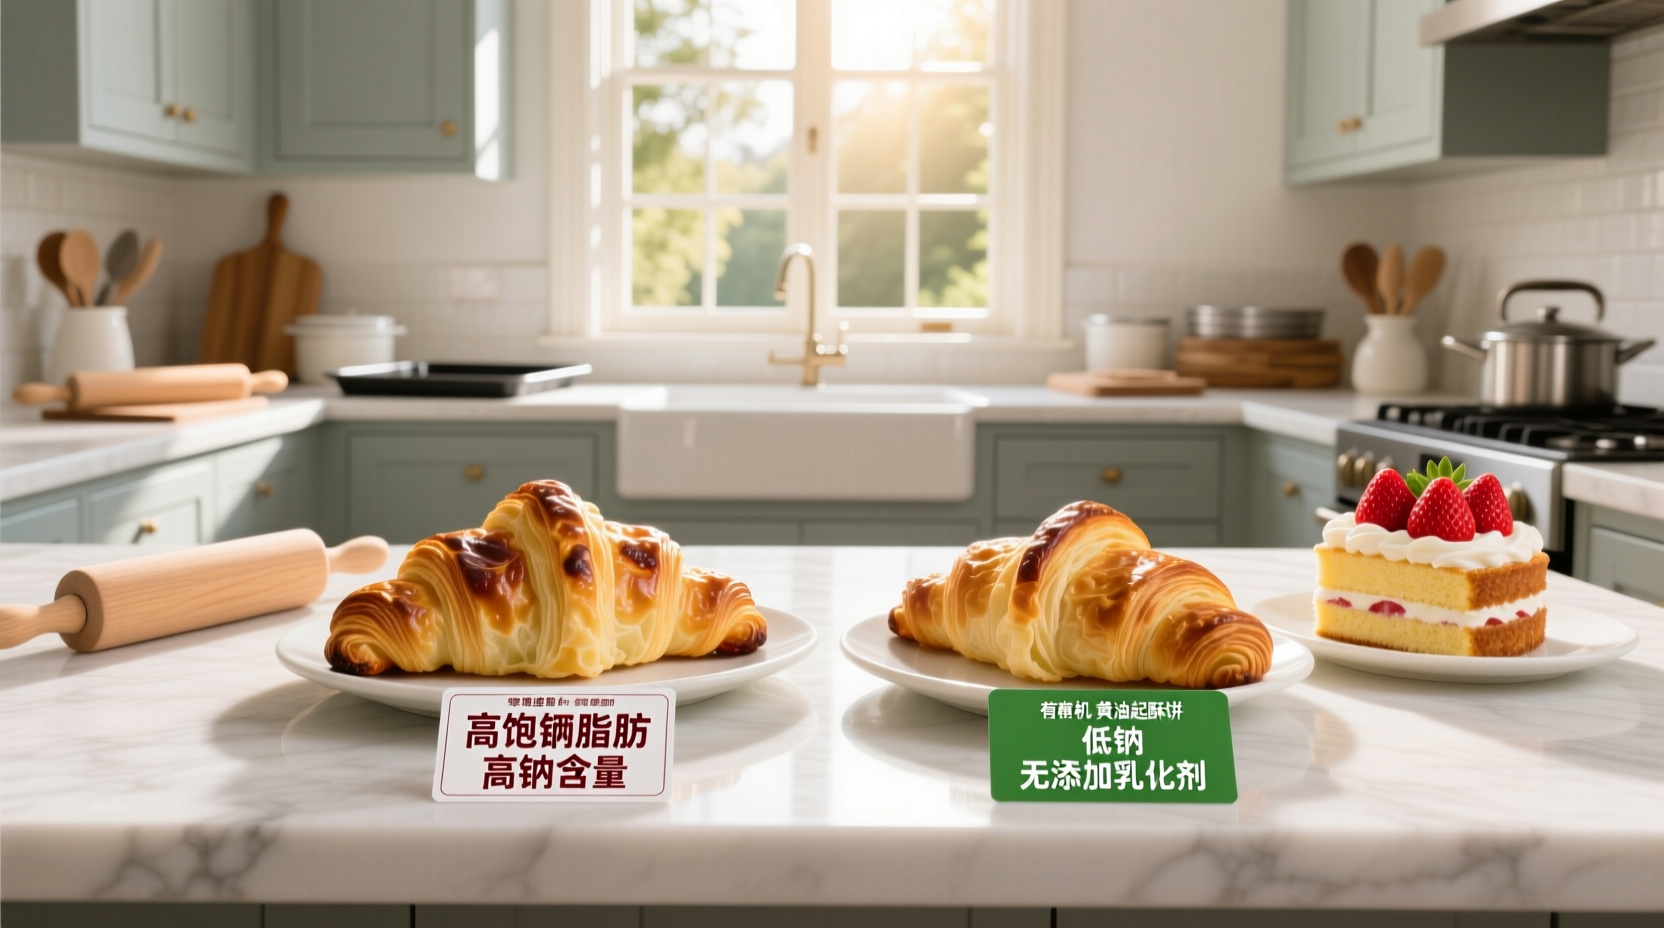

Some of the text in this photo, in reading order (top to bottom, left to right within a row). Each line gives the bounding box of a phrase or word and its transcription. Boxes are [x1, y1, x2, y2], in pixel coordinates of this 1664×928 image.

[1082, 725, 1144, 756] 低钠
[483, 753, 628, 790] 高钠含量
[1020, 759, 1206, 792] 无添加乳化剂
